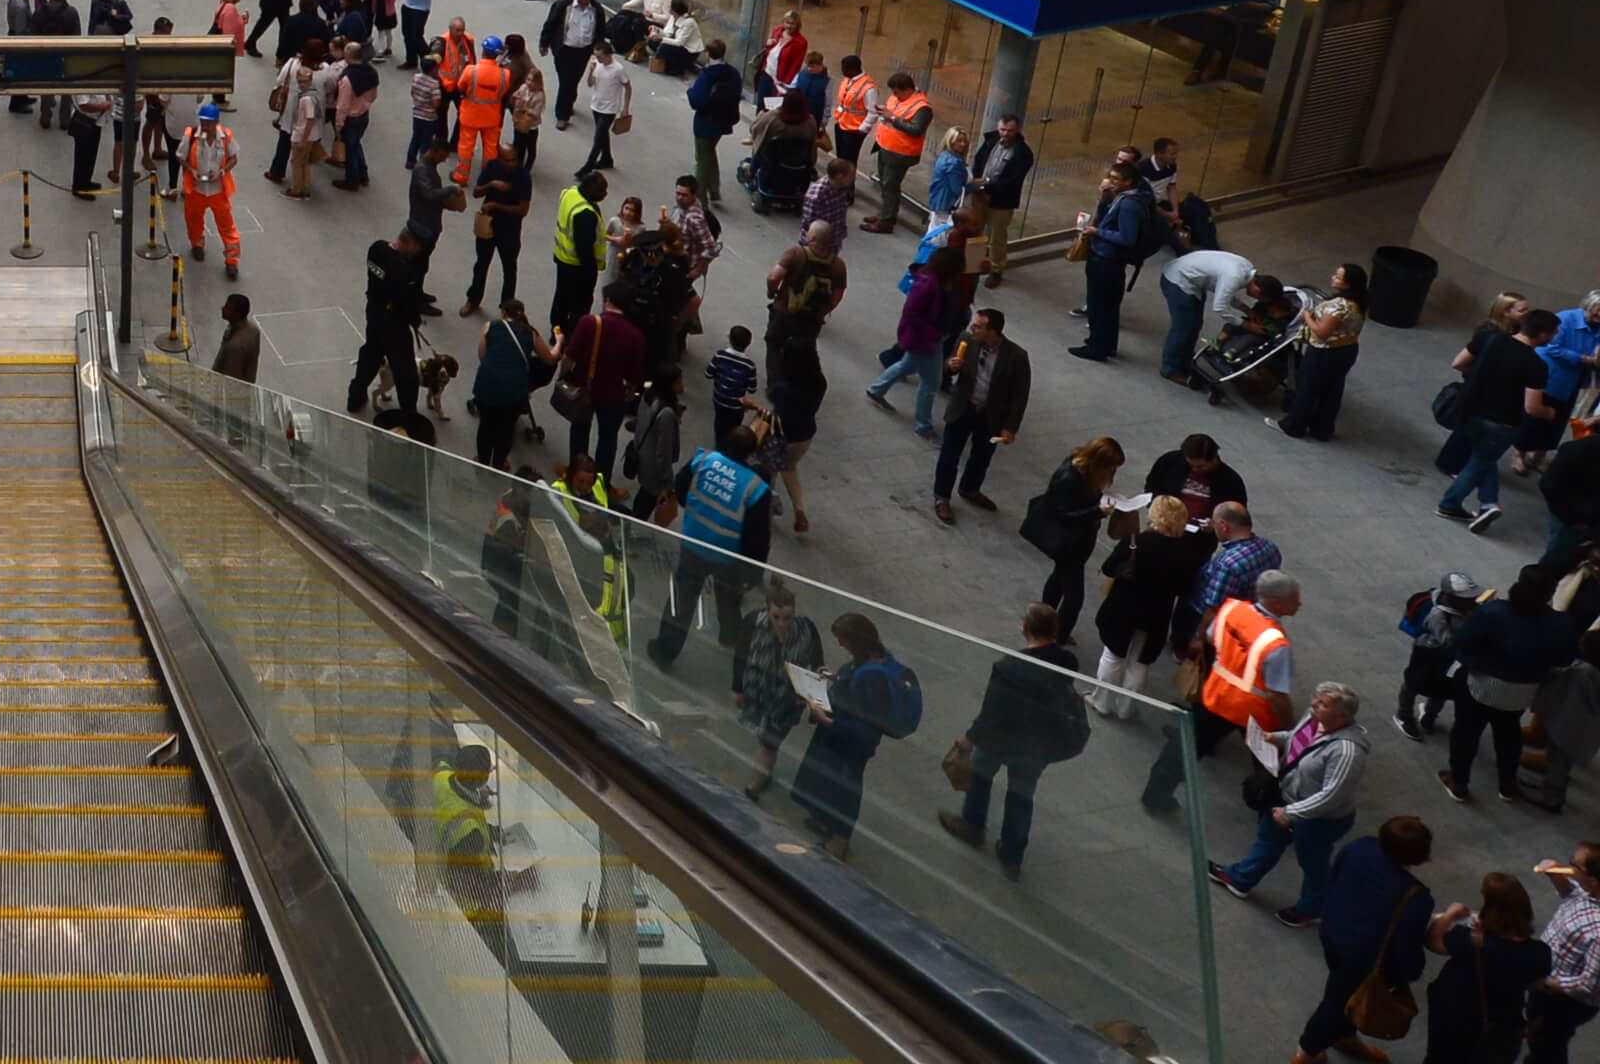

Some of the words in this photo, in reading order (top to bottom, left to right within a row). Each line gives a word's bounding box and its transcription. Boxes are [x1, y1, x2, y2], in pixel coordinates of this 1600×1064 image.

[705, 470, 737, 492] CARE
[712, 460, 737, 480] RAIL
[703, 481, 732, 503] TEAM
